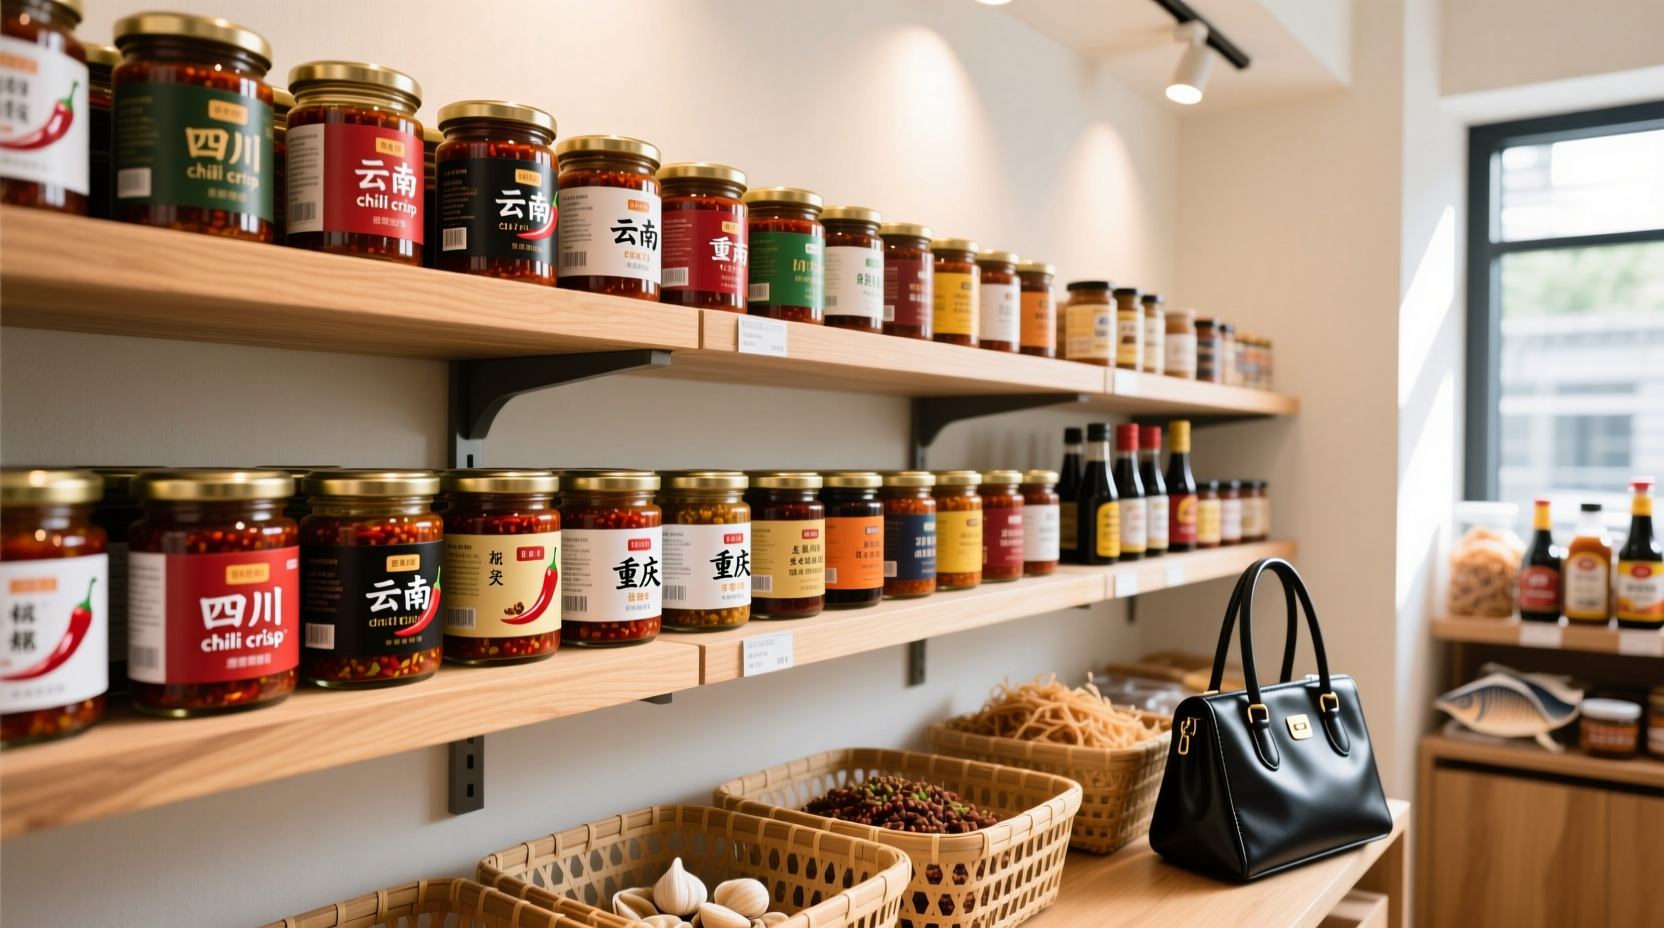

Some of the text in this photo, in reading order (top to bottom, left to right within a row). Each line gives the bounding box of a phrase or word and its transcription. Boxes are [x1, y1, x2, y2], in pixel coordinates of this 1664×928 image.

[184, 126, 261, 174] 四川
[354, 159, 417, 199] 云南
[495, 189, 550, 225] 云南
[610, 218, 658, 251] 云南
[612, 555, 662, 591] 重庆
[709, 549, 752, 581] 重庆
[199, 586, 283, 630] 四川
[365, 574, 431, 613] 云南
[200, 628, 284, 653] chili crisp
